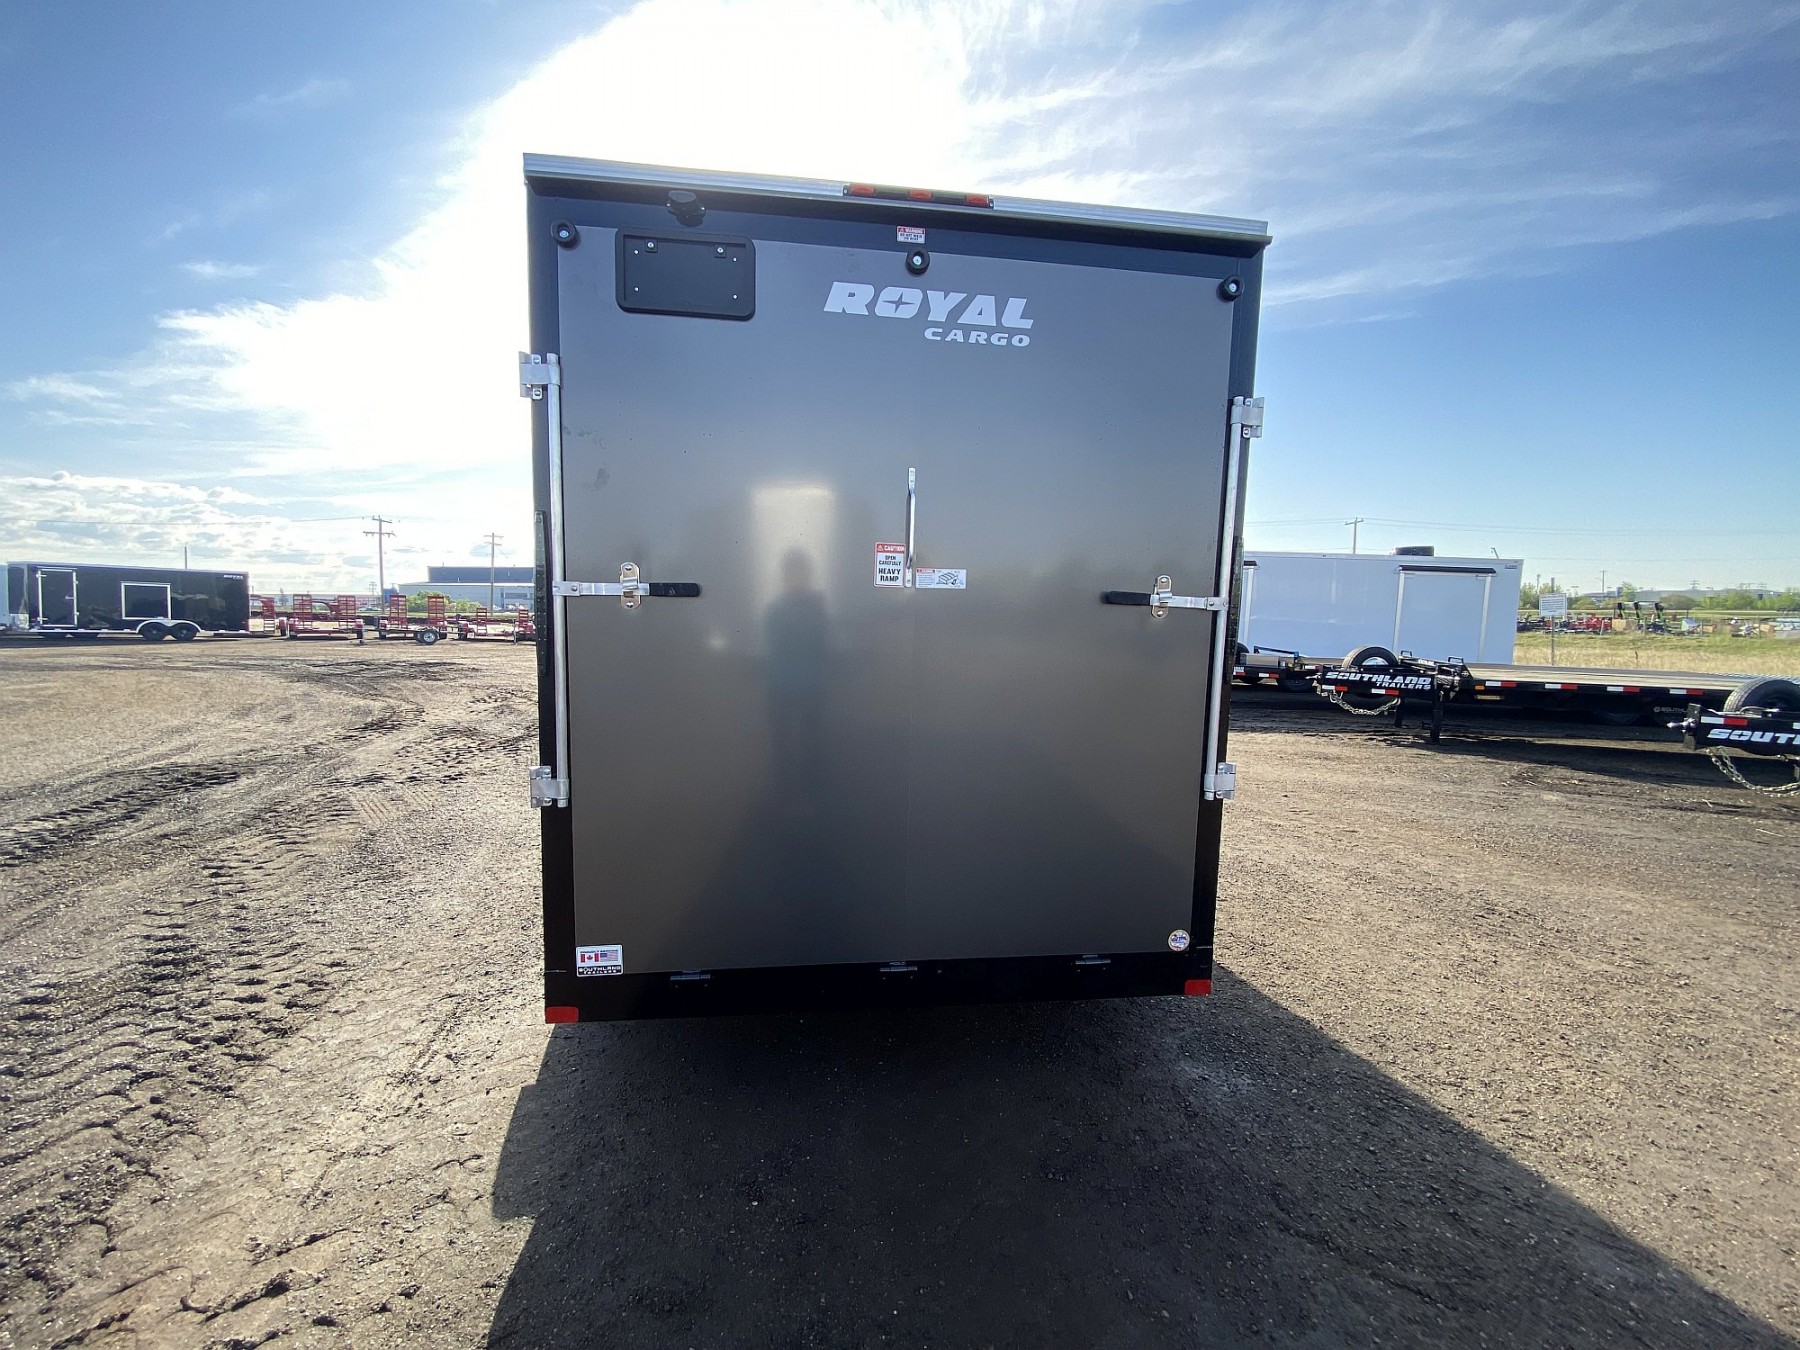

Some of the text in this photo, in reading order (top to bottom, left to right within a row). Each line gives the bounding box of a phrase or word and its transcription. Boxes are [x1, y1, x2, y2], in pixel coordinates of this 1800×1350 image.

[824, 281, 1034, 329] ROYAL
[924, 327, 1031, 347] CARGO
[1325, 671, 1432, 685] SOUTHLAND
[1376, 682, 1432, 690] TRAILERS
